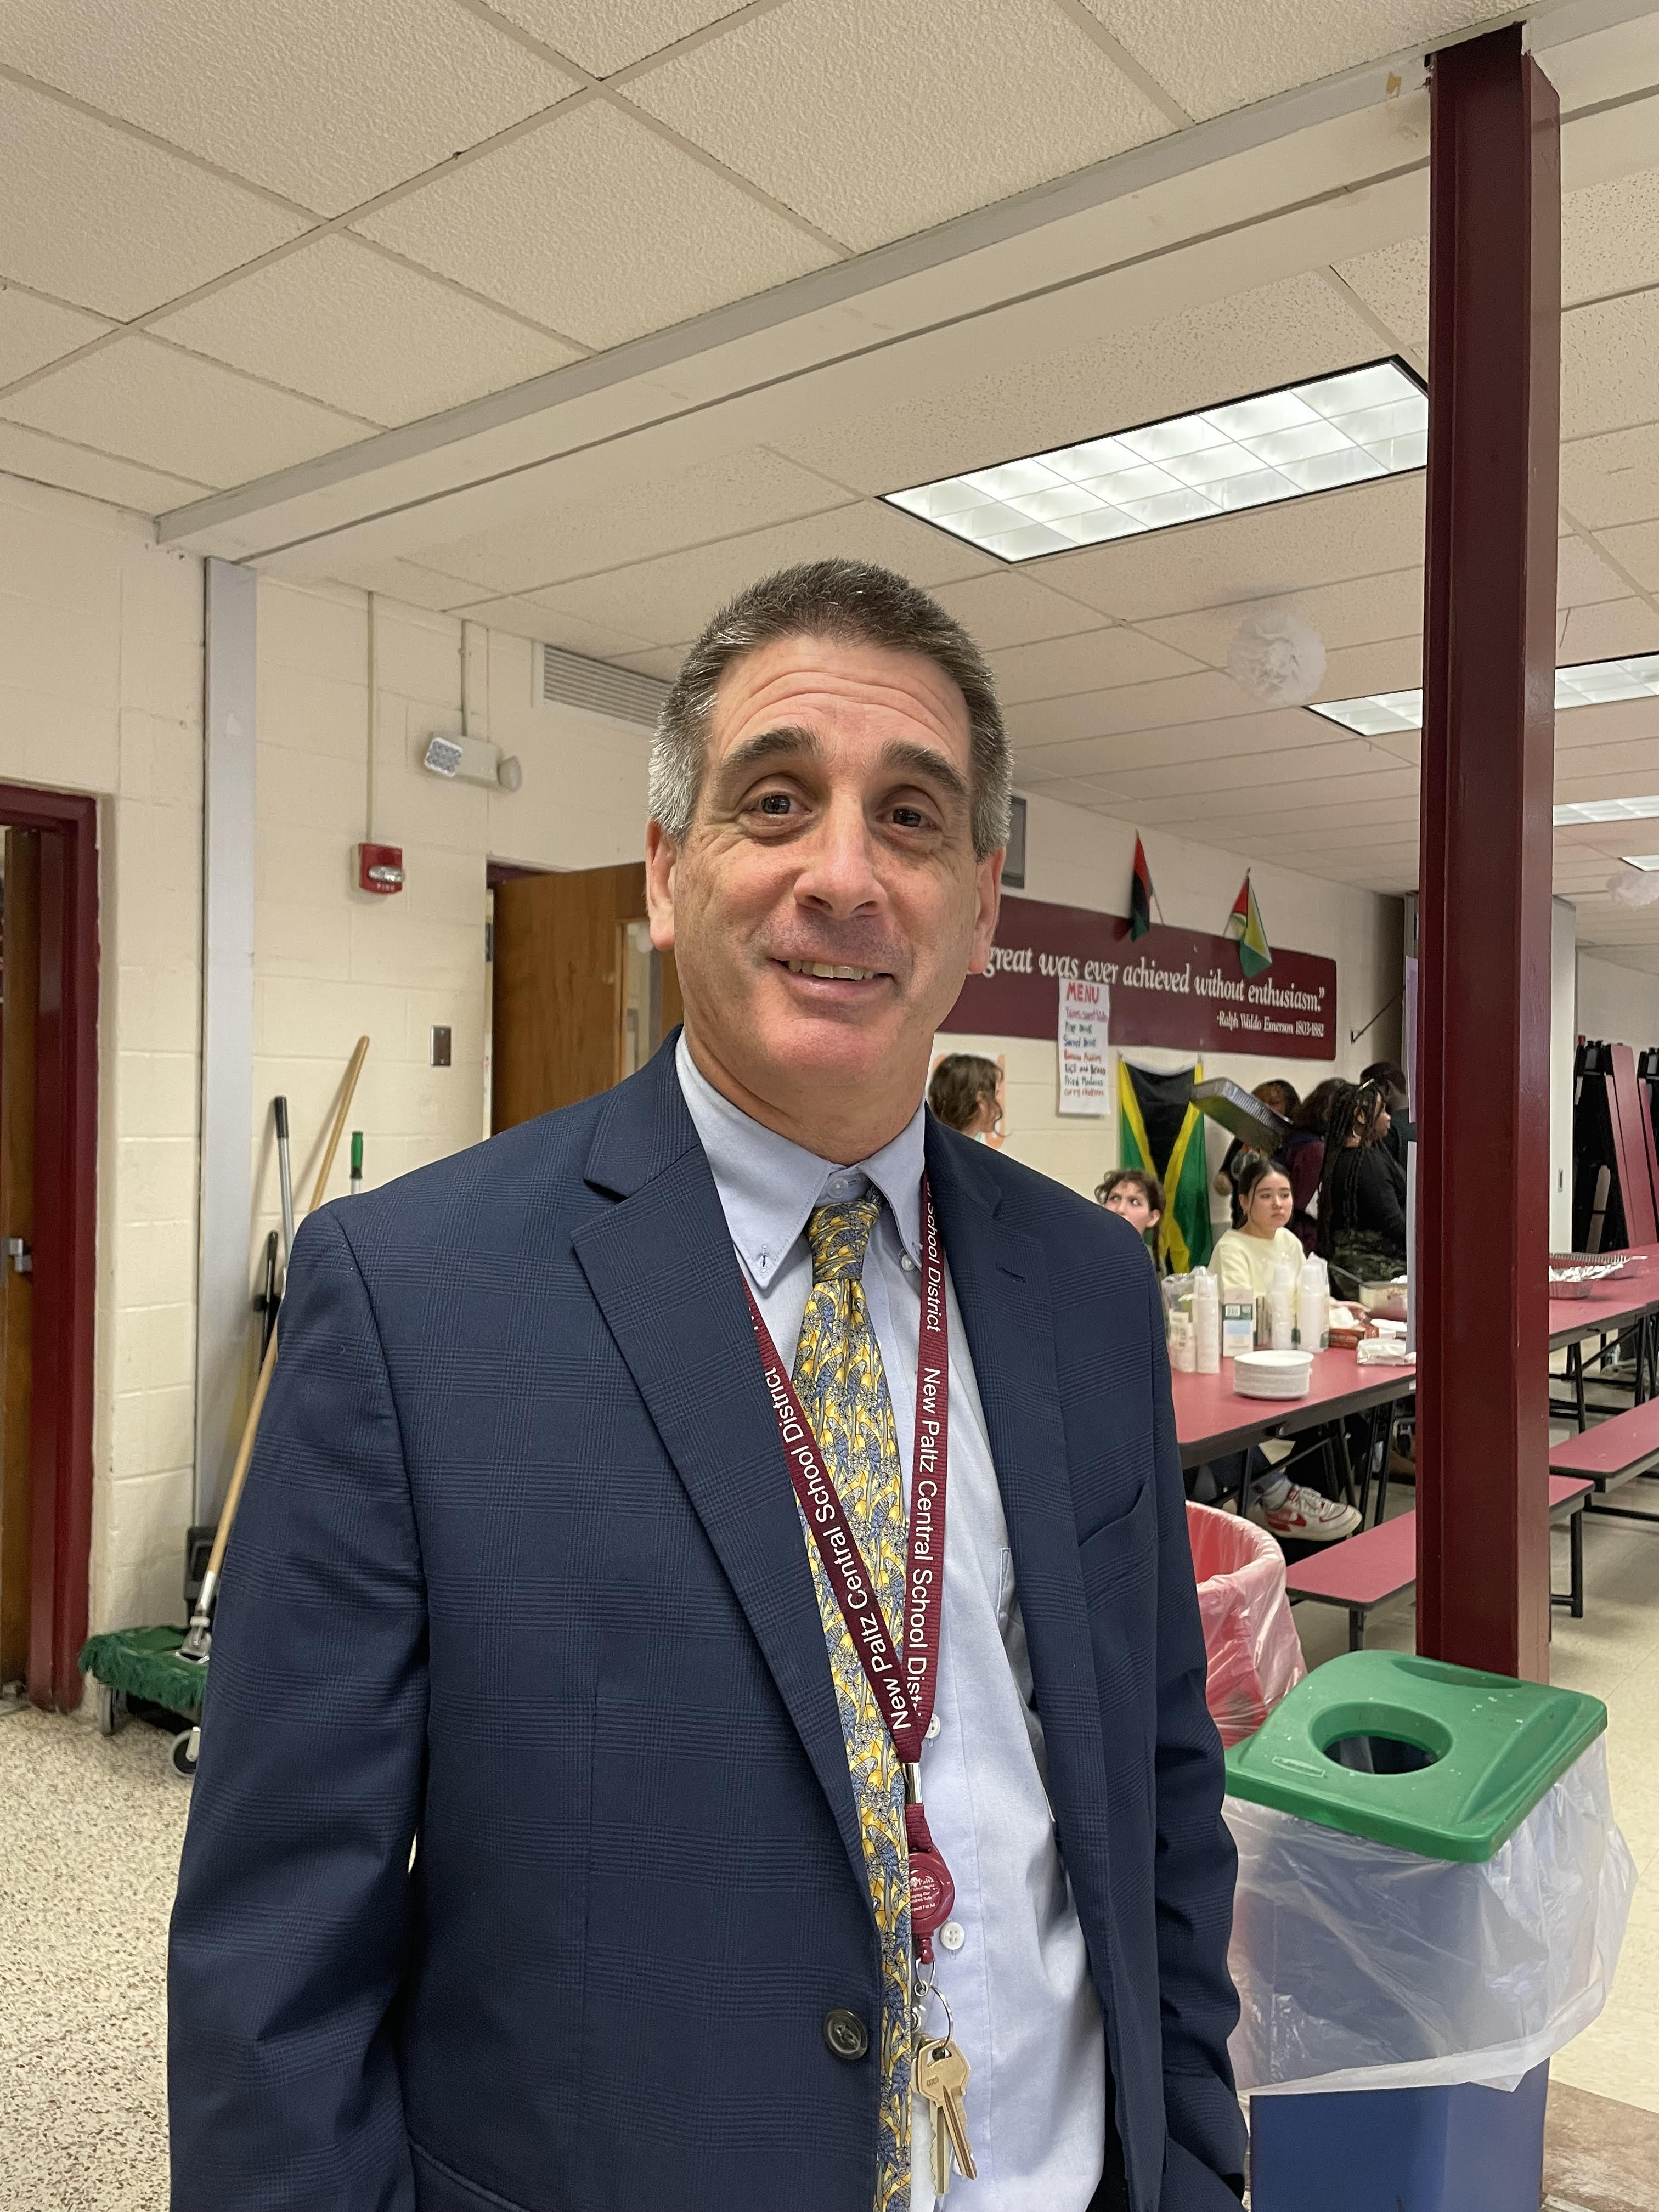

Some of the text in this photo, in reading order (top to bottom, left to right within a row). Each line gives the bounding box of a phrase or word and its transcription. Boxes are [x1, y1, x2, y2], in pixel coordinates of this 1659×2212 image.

[1038, 952, 1079, 979] was
[1084, 960, 1119, 984] ever
[1122, 956, 1190, 994] achieved
[1194, 968, 1245, 1002] without
[1066, 981, 1099, 1005] MENU
[1240, 1013, 1262, 1031] Waldo
[1263, 1015, 1294, 1035] Emerson
[1295, 1020, 1325, 1038] 1803-1882
[926, 1202, 941, 1333] School District
[765, 1367, 911, 1730] New Paltz Central School District
[907, 1368, 941, 1716] New Paltz Central School Dist
